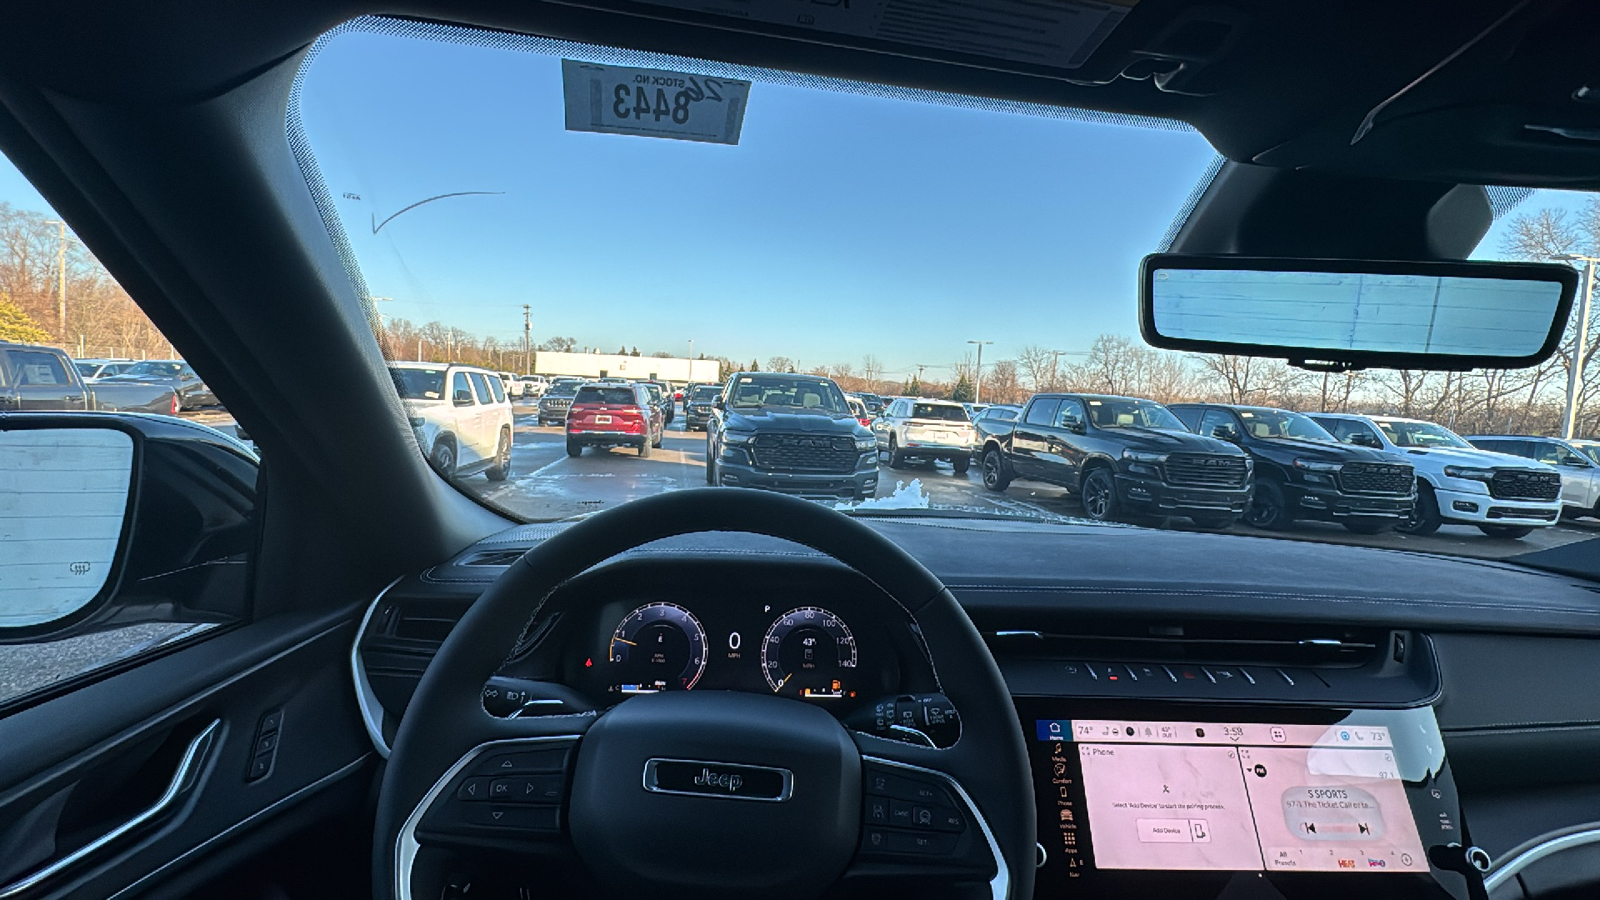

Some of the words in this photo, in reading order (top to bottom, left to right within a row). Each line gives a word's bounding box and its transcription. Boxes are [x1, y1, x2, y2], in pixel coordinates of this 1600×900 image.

[764, 605, 771, 613] P
[804, 611, 815, 619] 80
[783, 619, 794, 627] 60
[822, 619, 836, 628] 100
[728, 632, 741, 650] 0
[769, 636, 780, 644] 40
[836, 637, 849, 645] 120
[767, 661, 778, 669] 20
[838, 660, 852, 668] 140
[777, 679, 785, 688] 0
[1223, 727, 1244, 736] 3:58
[1370, 731, 1386, 741] 73°
[1092, 748, 1115, 756] Phone
[694, 768, 743, 792] Jeep
[495, 784, 508, 792] OK
[1315, 789, 1348, 799] SPORTS
[1304, 801, 1317, 809] The
[1317, 801, 1339, 809] Ticket
